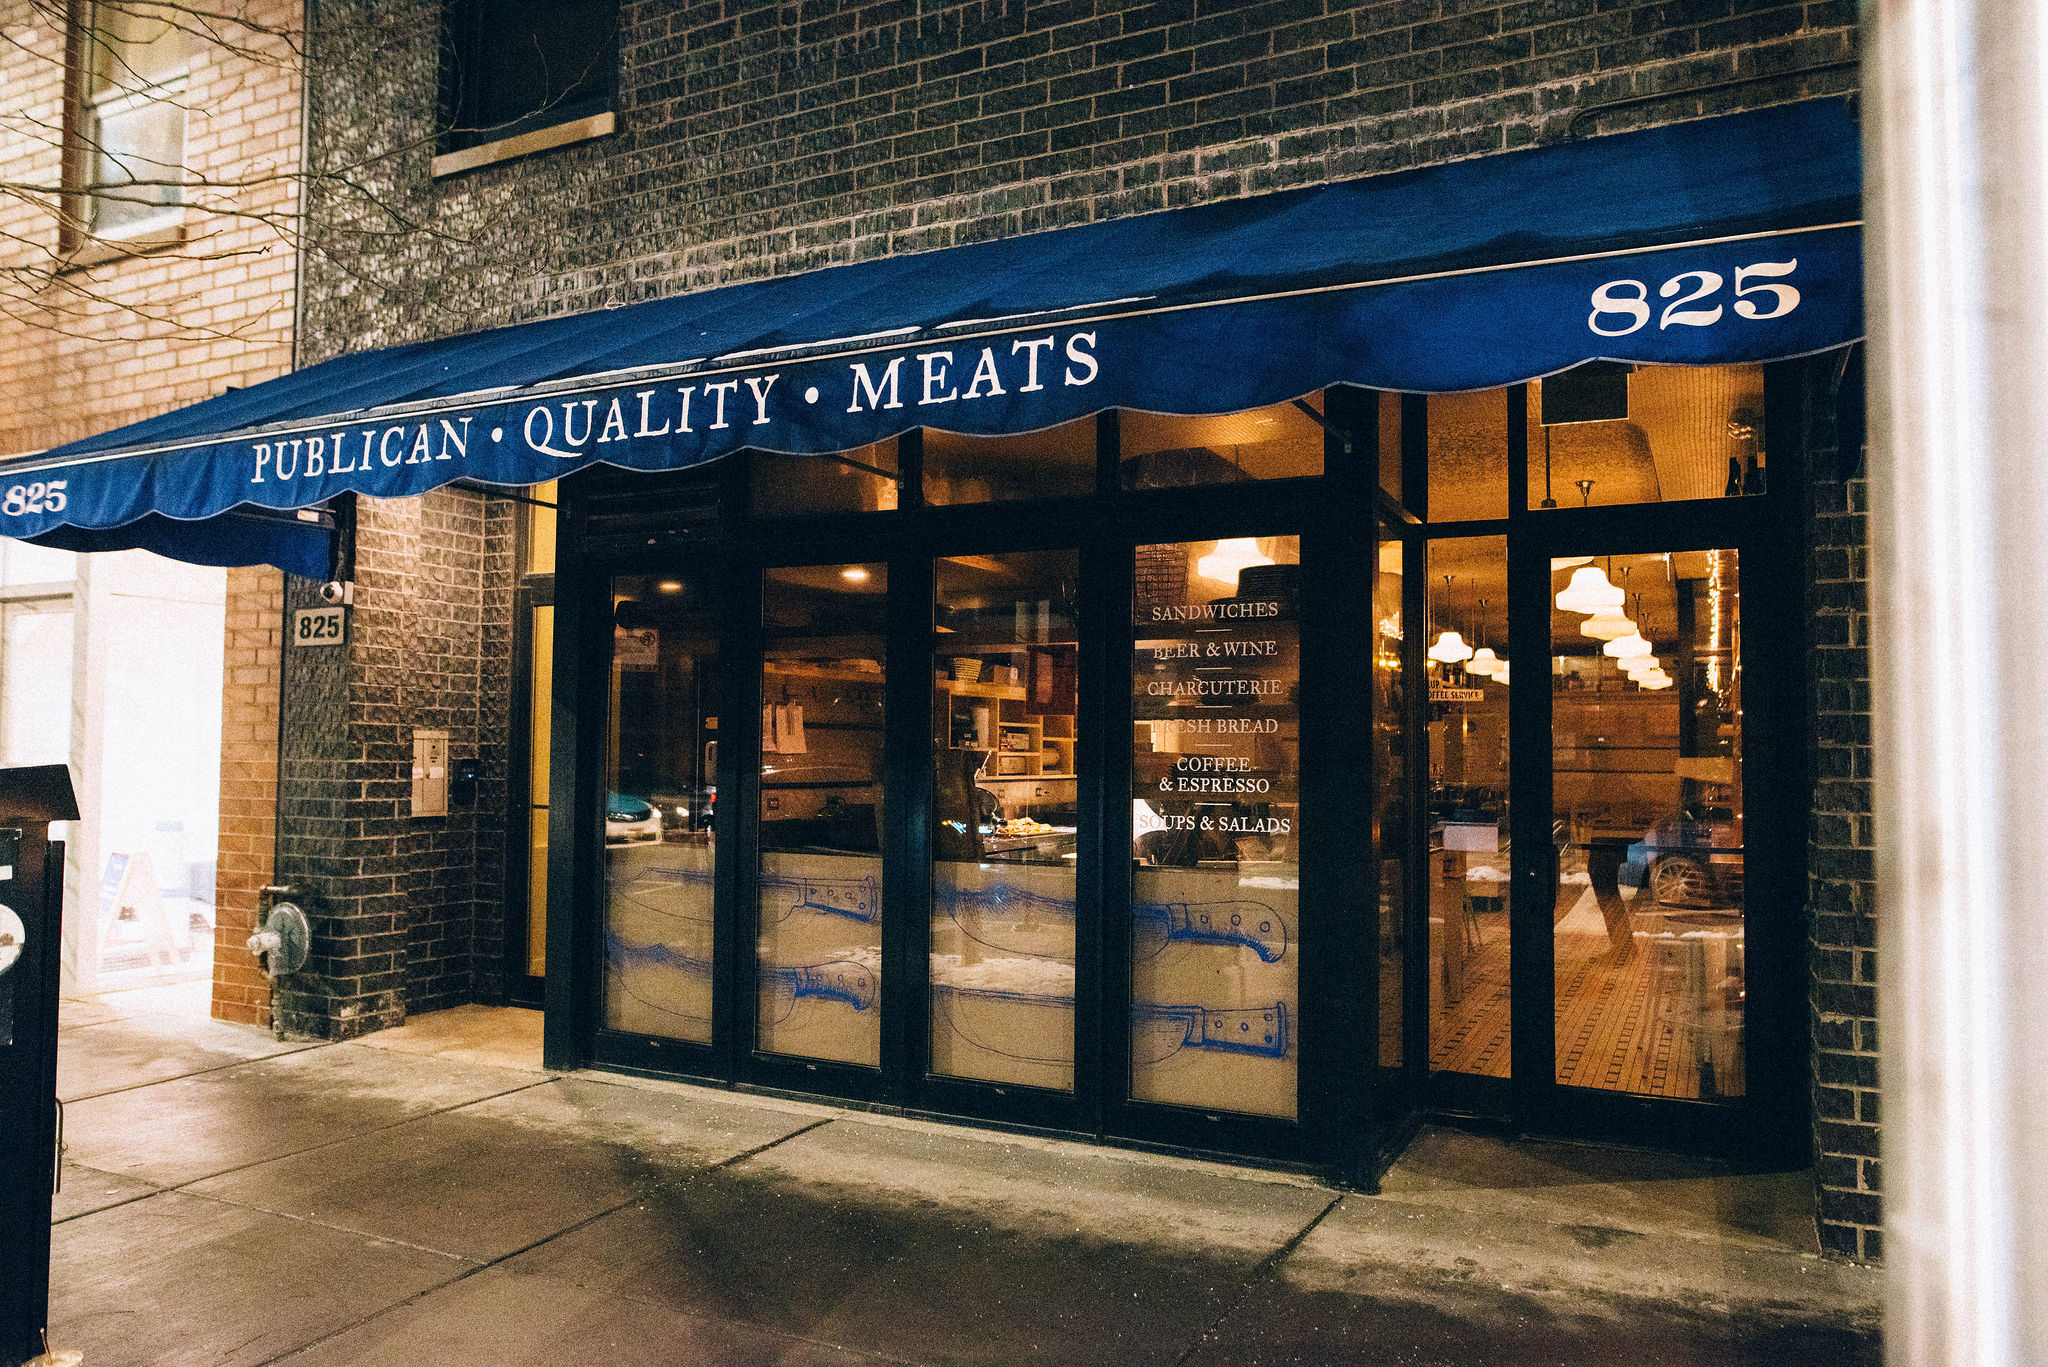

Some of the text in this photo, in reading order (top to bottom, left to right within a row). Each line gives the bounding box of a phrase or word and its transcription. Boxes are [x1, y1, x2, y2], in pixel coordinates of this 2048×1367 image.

[1588, 257, 1801, 337] 825
[251, 330, 1099, 484] PUBLICAN QUALITY MEATS
[1, 480, 68, 517] 825
[1152, 601, 1279, 621] SANDWICHES
[300, 614, 340, 639] 825
[1153, 640, 1278, 659] BEER & WINE
[1147, 679, 1283, 696] CHARCUTERIE
[1217, 719, 1278, 733] BREAD
[1177, 757, 1251, 772] COFFEE
[1159, 777, 1270, 793] & ESPRESSO
[1139, 814, 1291, 833] SOUPS & SALADS
